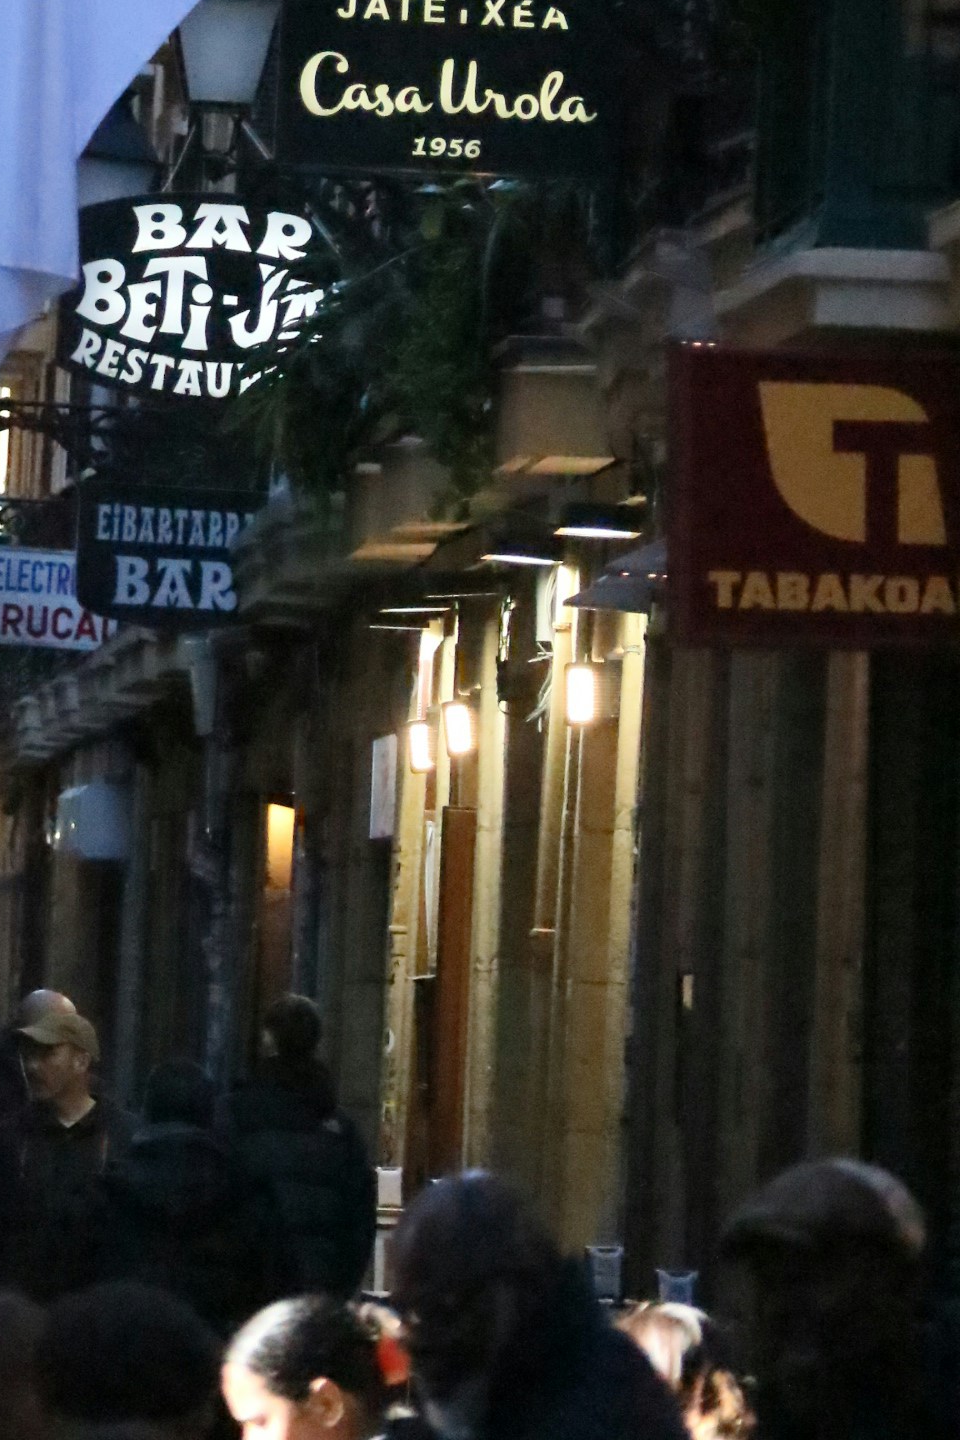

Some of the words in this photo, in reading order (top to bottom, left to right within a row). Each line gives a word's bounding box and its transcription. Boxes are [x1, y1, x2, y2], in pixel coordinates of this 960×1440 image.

[299, 50, 433, 117] Casa
[440, 58, 598, 123] Urola
[411, 136, 482, 158] 1956
[131, 203, 313, 260] BAR
[113, 555, 237, 611] BAR
